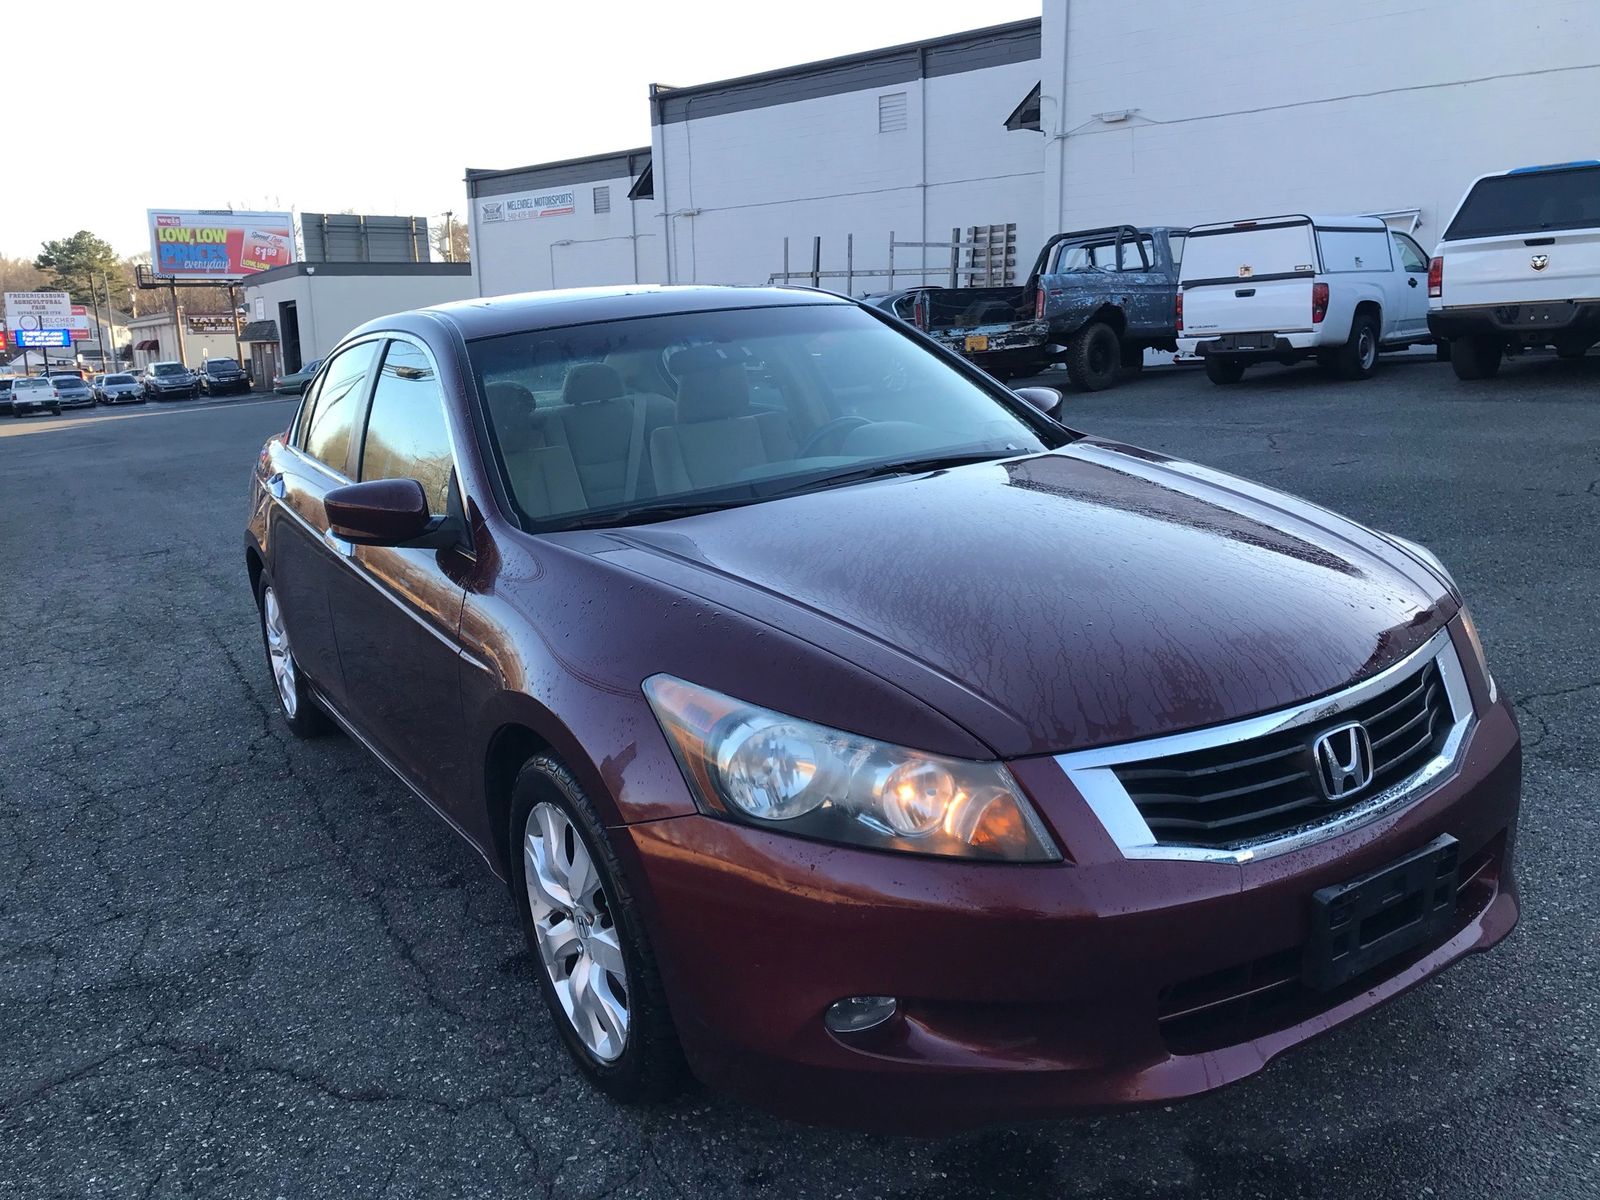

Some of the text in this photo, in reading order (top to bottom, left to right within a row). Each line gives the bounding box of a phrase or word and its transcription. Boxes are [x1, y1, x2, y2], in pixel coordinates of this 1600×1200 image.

[534, 192, 573, 207] MOTORSPORTS
[195, 227, 227, 243] LOW
[160, 243, 229, 268] PRICES
